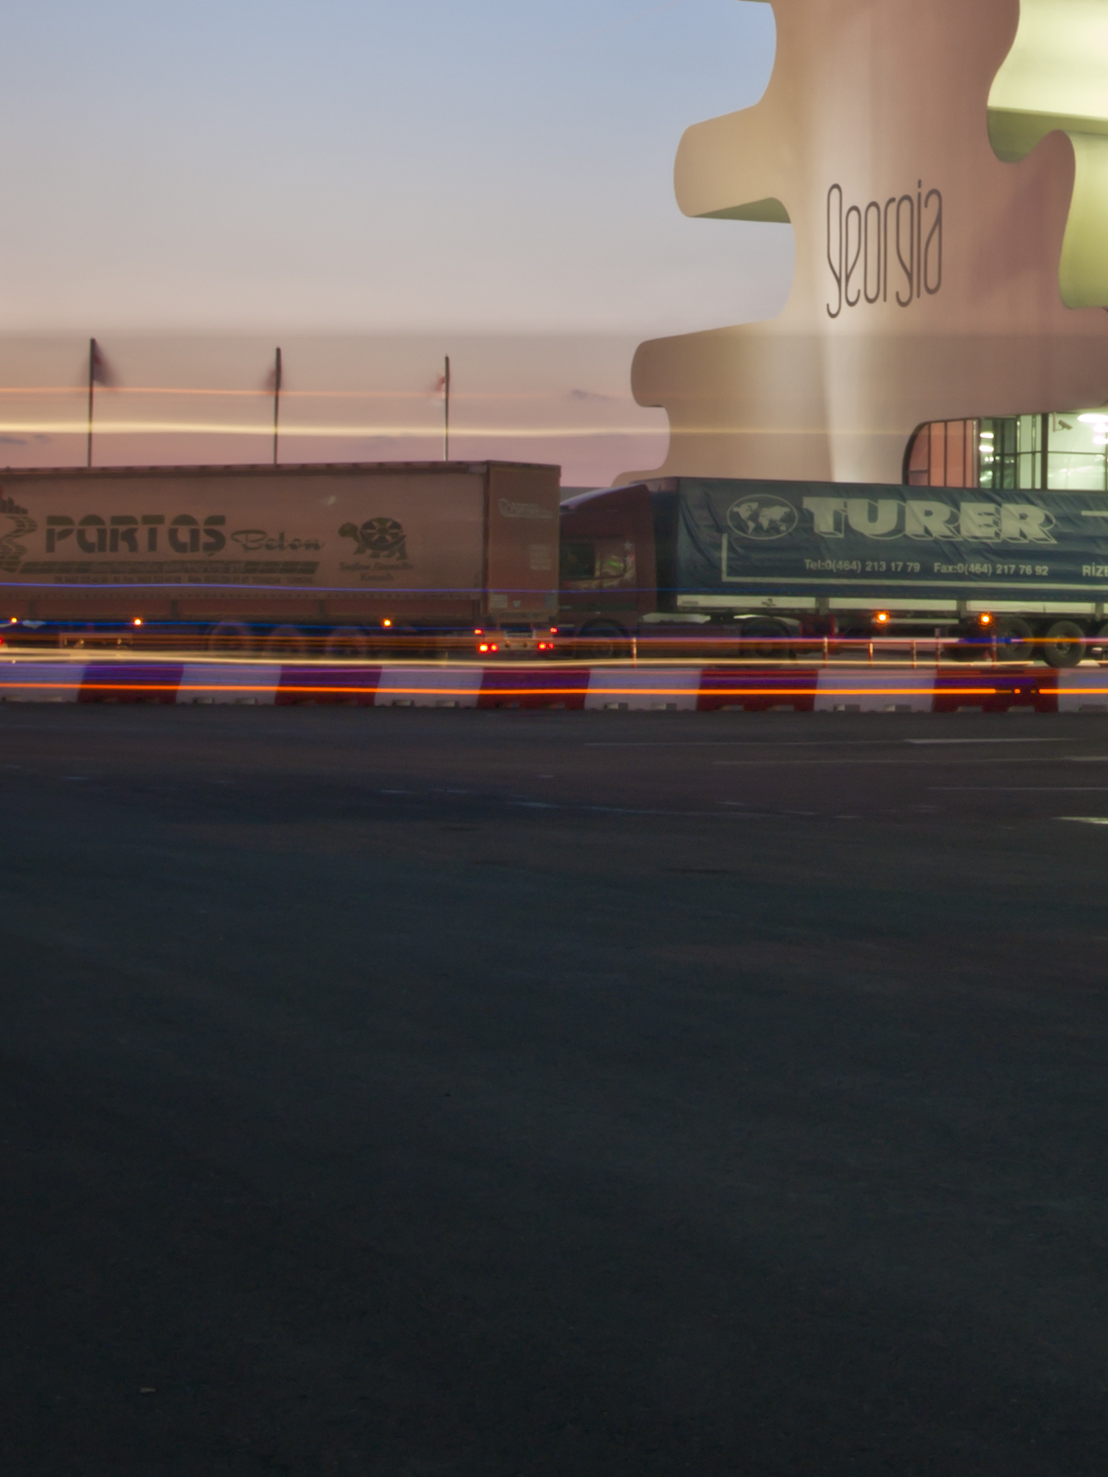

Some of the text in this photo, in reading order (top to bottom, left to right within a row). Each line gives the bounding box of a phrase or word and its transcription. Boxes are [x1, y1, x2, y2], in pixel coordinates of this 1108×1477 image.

[802, 496, 1058, 544] TURER
[865, 560, 886, 572] 213
[891, 561, 904, 572] 17
[906, 562, 921, 573] 79
[996, 564, 1016, 575] 217
[1034, 565, 1049, 576] 92
